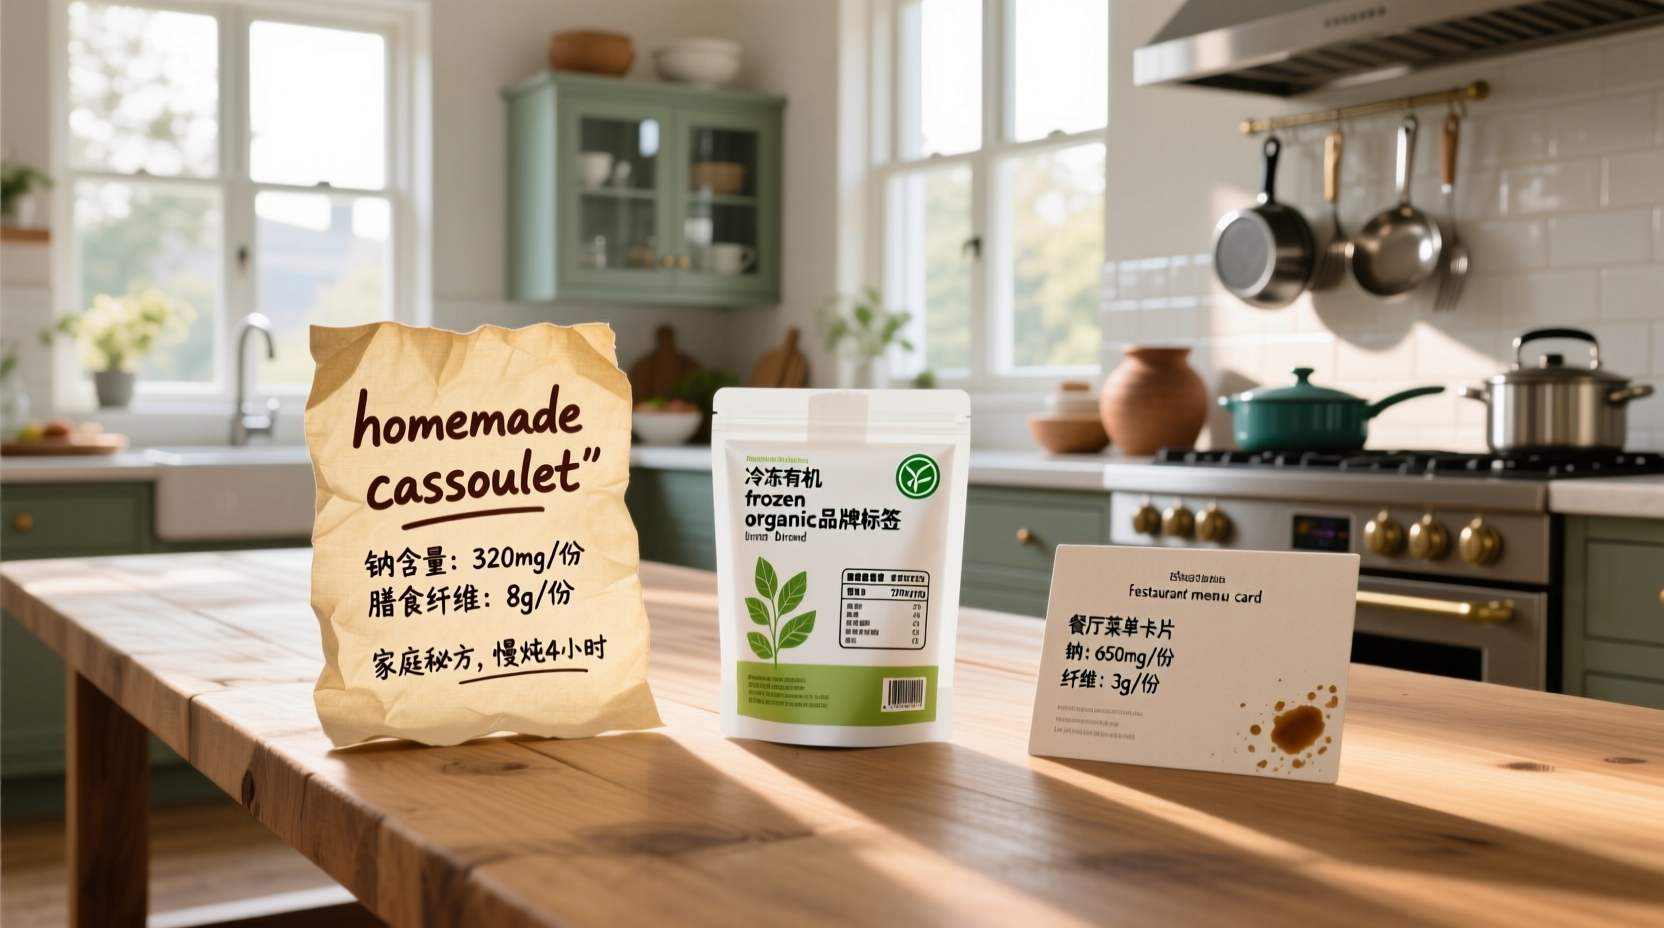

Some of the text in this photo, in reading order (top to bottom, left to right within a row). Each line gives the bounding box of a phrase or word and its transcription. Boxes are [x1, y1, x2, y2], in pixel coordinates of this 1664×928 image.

[353, 384, 583, 449] homemade
[745, 466, 823, 488] 冷冻有机
[745, 490, 806, 507] frozen
[1191, 591, 1230, 602] menu
[1234, 590, 1263, 604] card
[1068, 613, 1175, 640] 餐厅菜单卡片
